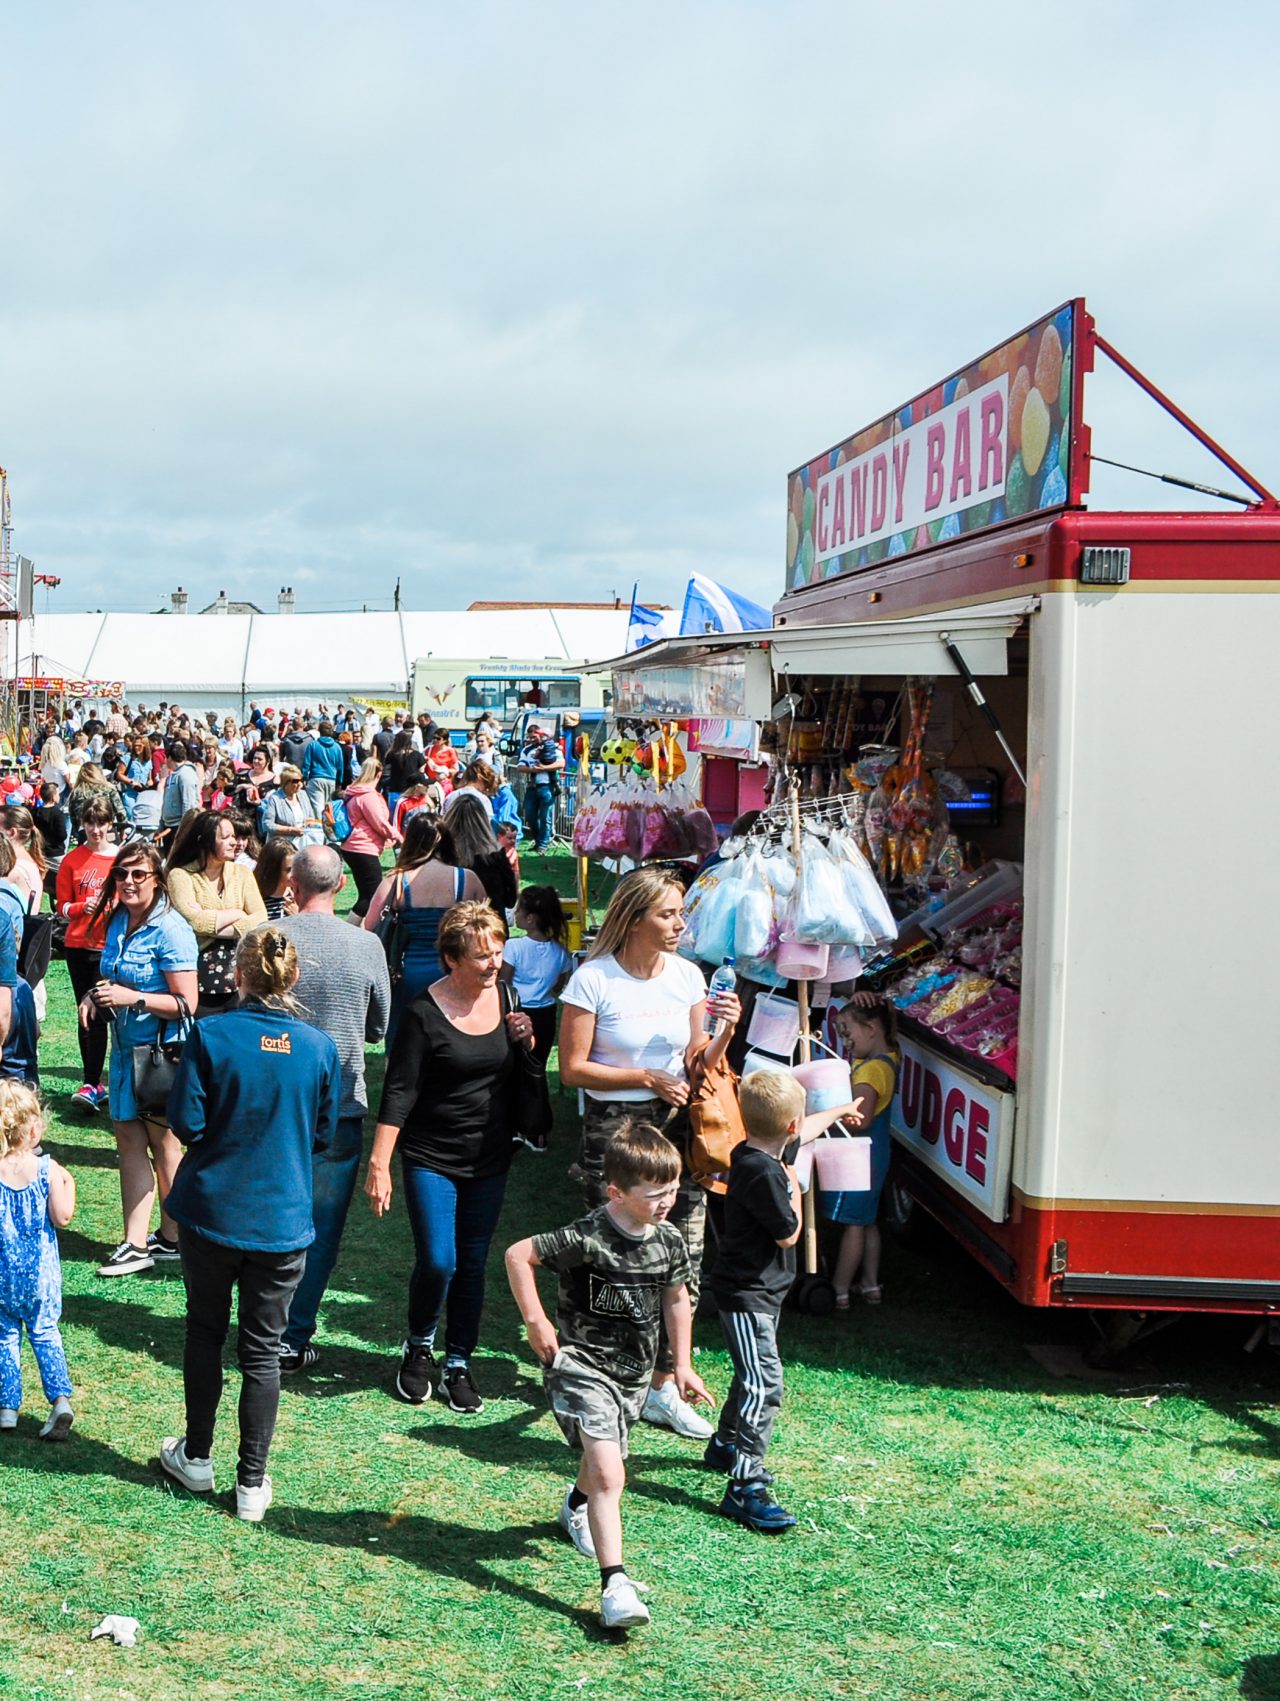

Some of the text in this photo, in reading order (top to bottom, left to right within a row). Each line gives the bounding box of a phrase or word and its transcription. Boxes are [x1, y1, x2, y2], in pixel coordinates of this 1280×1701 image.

[818, 391, 1004, 552] CANDY BAR
[261, 1033, 291, 1048] fortis
[896, 1054, 990, 1187] UDGE
[595, 1284, 660, 1317] AWESO
